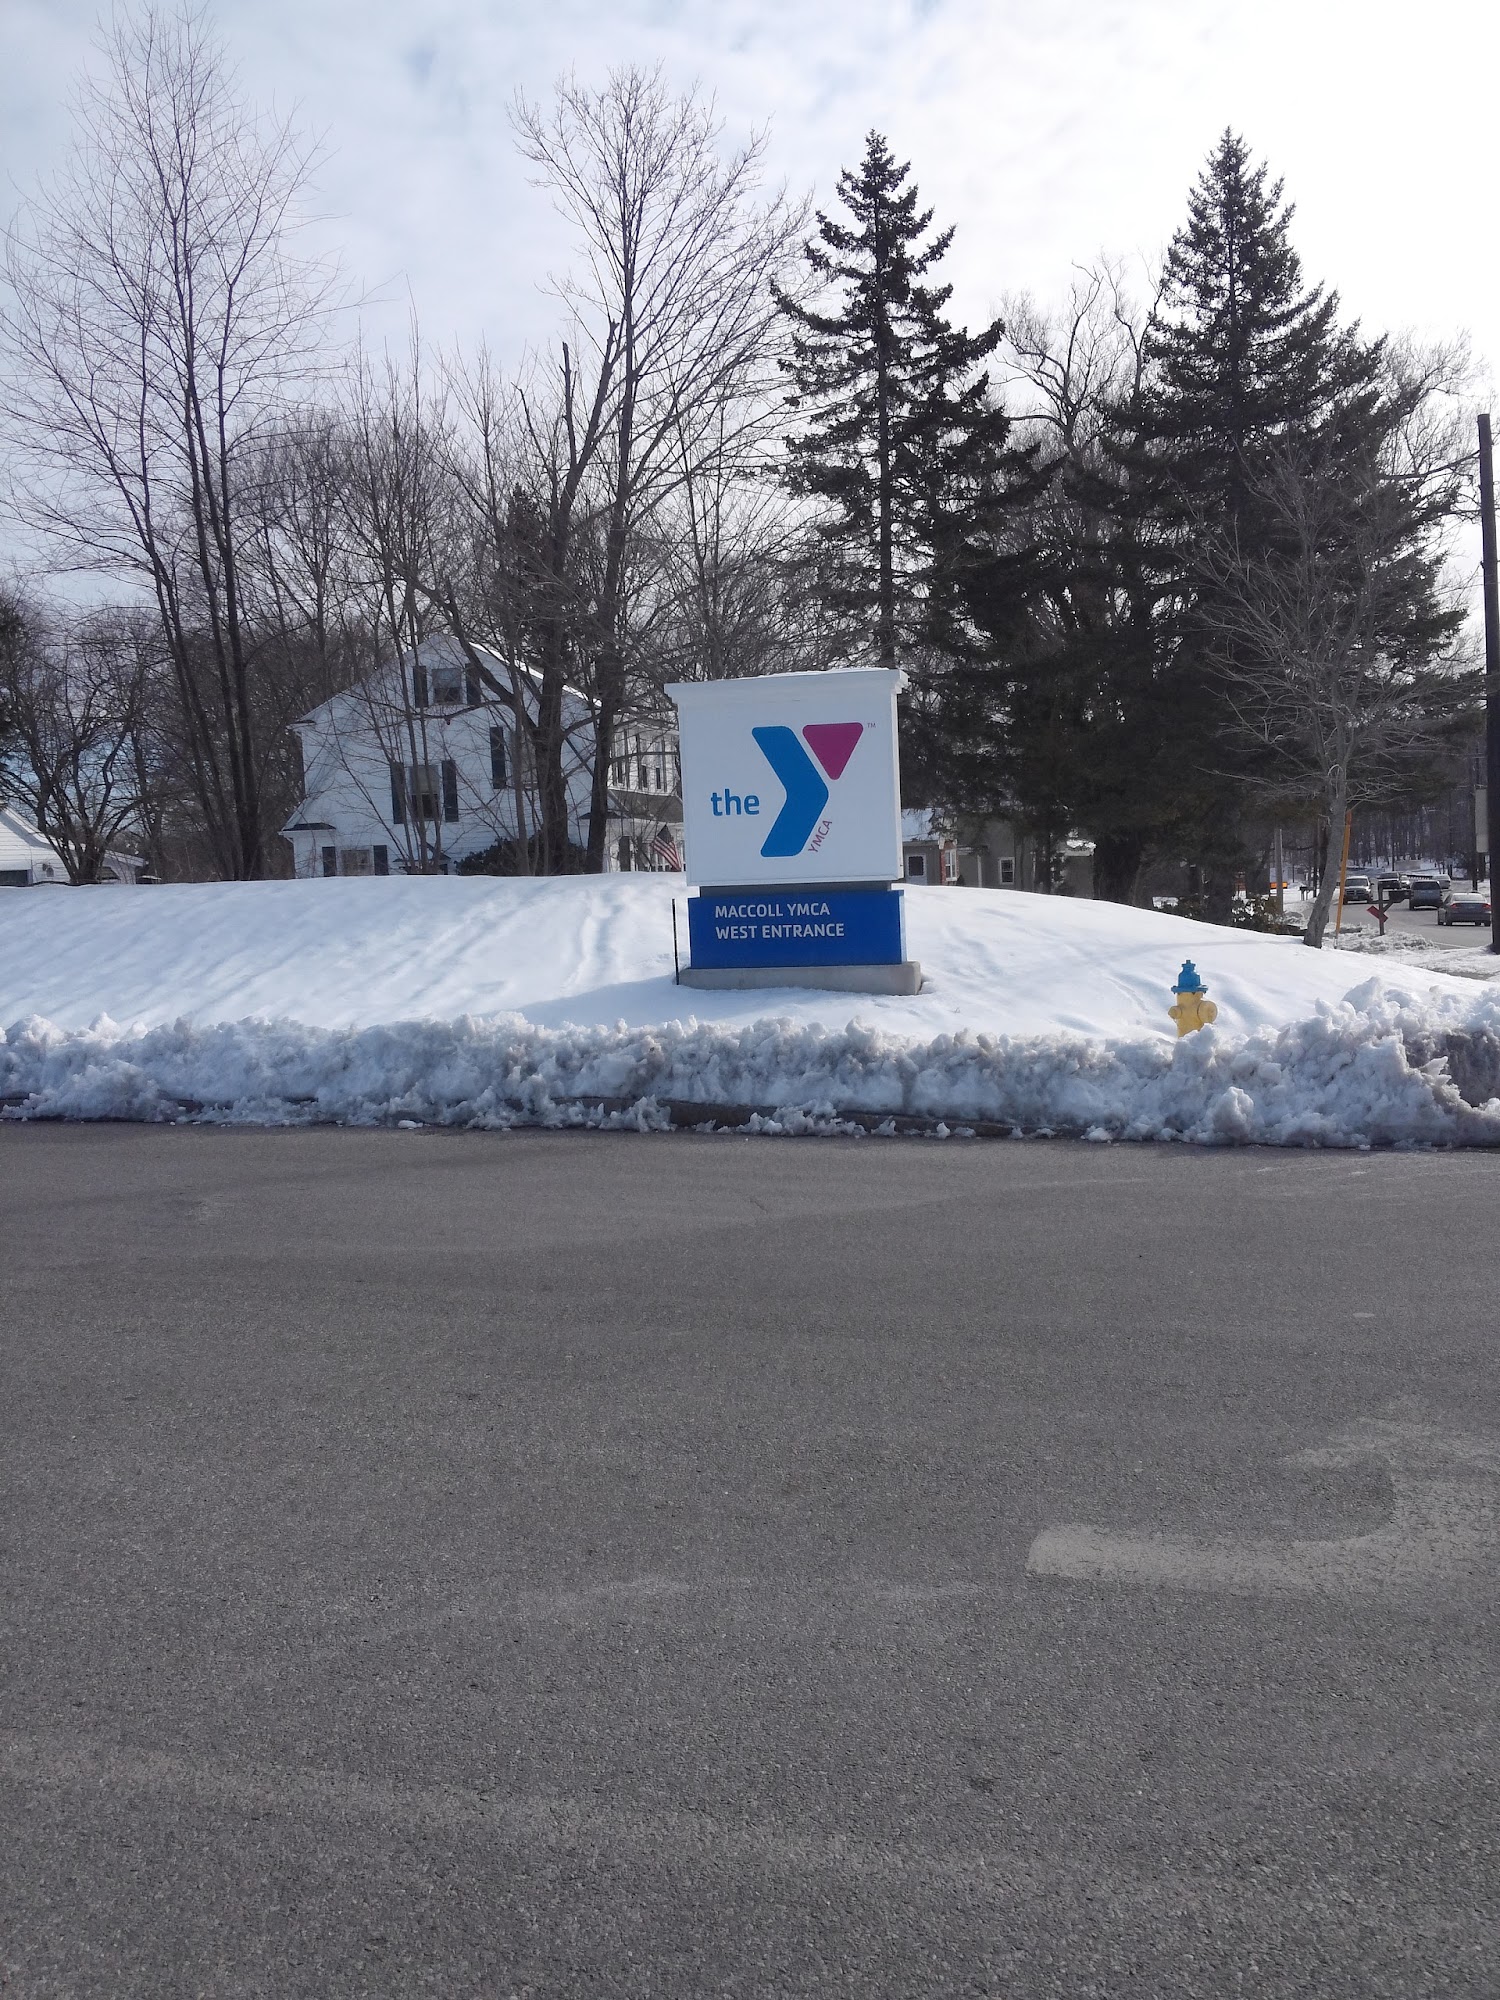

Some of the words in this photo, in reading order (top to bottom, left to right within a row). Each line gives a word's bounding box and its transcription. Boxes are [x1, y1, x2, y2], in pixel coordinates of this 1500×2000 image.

[711, 788, 760, 816] the
[808, 819, 833, 854] YMCA
[715, 903, 783, 918] MACCOLL
[787, 902, 830, 916] YMCA
[715, 925, 758, 939] WEST
[762, 923, 845, 938] ENTRANCE
